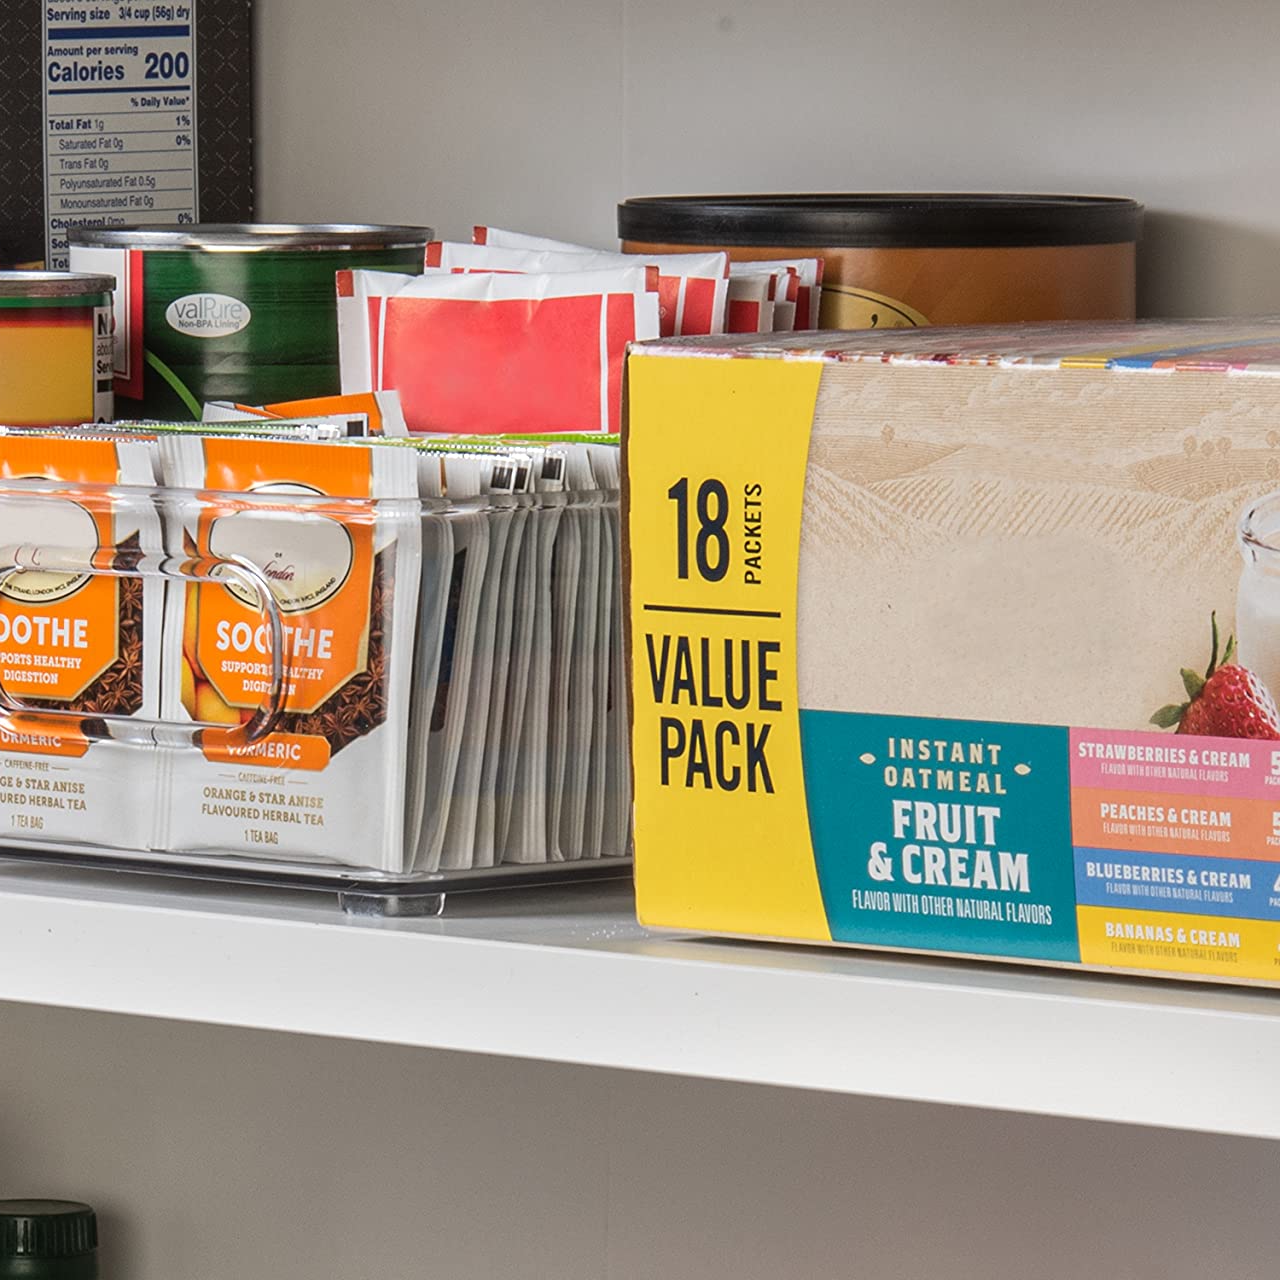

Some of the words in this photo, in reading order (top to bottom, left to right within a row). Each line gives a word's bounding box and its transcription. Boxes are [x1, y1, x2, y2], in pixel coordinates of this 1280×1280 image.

[48, 61, 124, 82] Calories
[145, 52, 189, 79] 200
[175, 298, 242, 319] valPure
[179, 319, 213, 328] Non-BPA
[668, 477, 730, 582] 18
[744, 484, 762, 585] PACKETS
[34, 655, 81, 669] HEALTHY
[646, 633, 782, 712] VALUE
[4, 670, 58, 684] DIGESTION
[227, 744, 301, 760] TURMERIC
[660, 717, 775, 794] PACK
[889, 737, 1001, 765] INSTANT
[1078, 742, 1186, 764] STRAWBERRIES
[1189, 750, 1198, 765] &
[1201, 750, 1250, 768] CREAM
[16, 778, 23, 788] &
[25, 777, 50, 790] STAR
[53, 781, 85, 794] ANISE
[884, 766, 1007, 794] OATMEAL
[29, 795, 65, 809] HERBAL
[67, 799, 86, 810] TEA
[204, 787, 246, 801] ORANGE
[249, 791, 255, 801] &
[259, 792, 285, 805] STAR
[289, 795, 324, 809] ANISE
[202, 804, 260, 819] FLAVOURED
[263, 809, 301, 823] HERBAL
[304, 814, 324, 825] TEA
[892, 800, 1000, 845] FRUIT
[1100, 803, 1163, 823] PEACHES
[1168, 809, 1177, 823] &
[1181, 809, 1231, 827] CREAM
[868, 842, 895, 882] &
[902, 844, 1031, 893] CREAM
[1086, 861, 1183, 884] BLUEBERRIES
[1187, 871, 1197, 885] &
[1200, 870, 1251, 889] CREAM
[853, 889, 890, 912] FLAVOR
[892, 893, 919, 914] WITH
[921, 895, 953, 917] OTHER
[956, 898, 1004, 921] NATURAL
[1006, 903, 1052, 925] FLAVORS
[1105, 922, 1173, 942] BANANAS
[1177, 931, 1185, 943] &
[1190, 930, 1240, 948] CREAM
